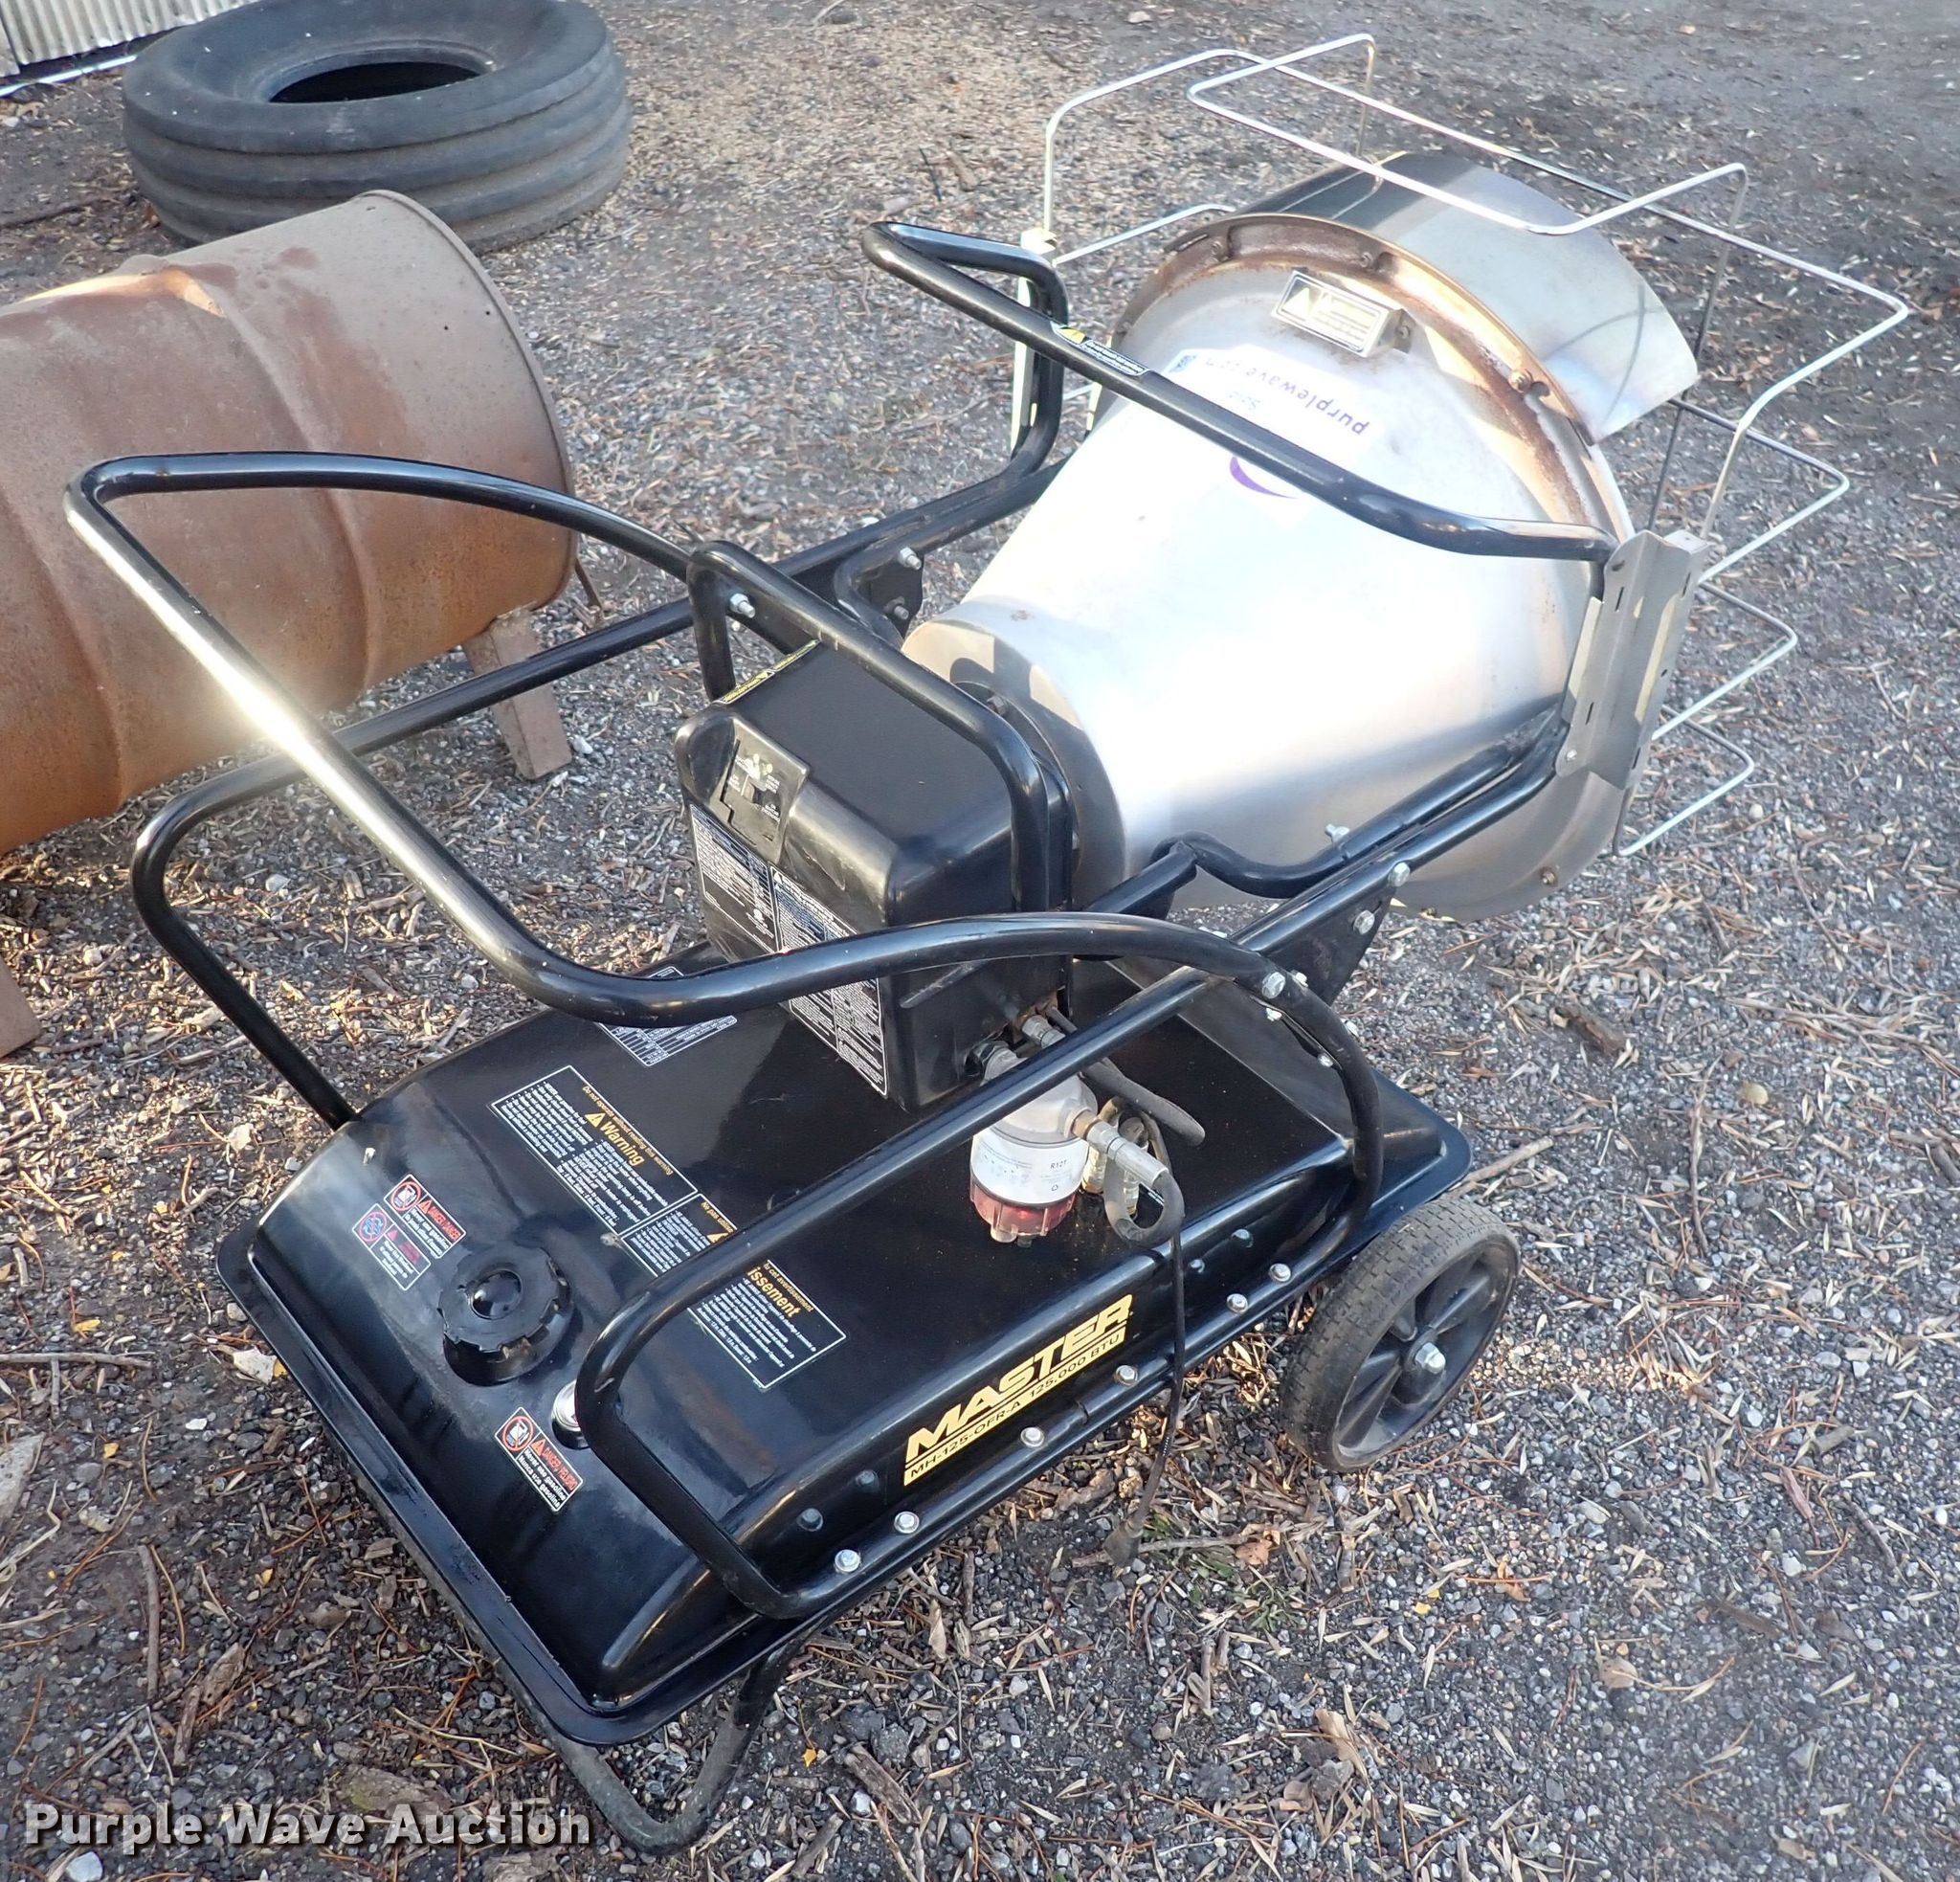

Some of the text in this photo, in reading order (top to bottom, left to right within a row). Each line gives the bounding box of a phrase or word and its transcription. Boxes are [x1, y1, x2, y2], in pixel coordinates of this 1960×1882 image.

[602, 1122, 644, 1166] Warning
[777, 1277, 813, 1311] avertissement
[905, 1293, 1133, 1463] MASTER
[910, 1400, 1021, 1478] MH-125-OFR-A
[1090, 1334, 1120, 1358] BTU
[518, 1455, 533, 1474] Nunca
[539, 1481, 561, 1507] gasolina
[523, 1448, 566, 1501] Never use gasoline
